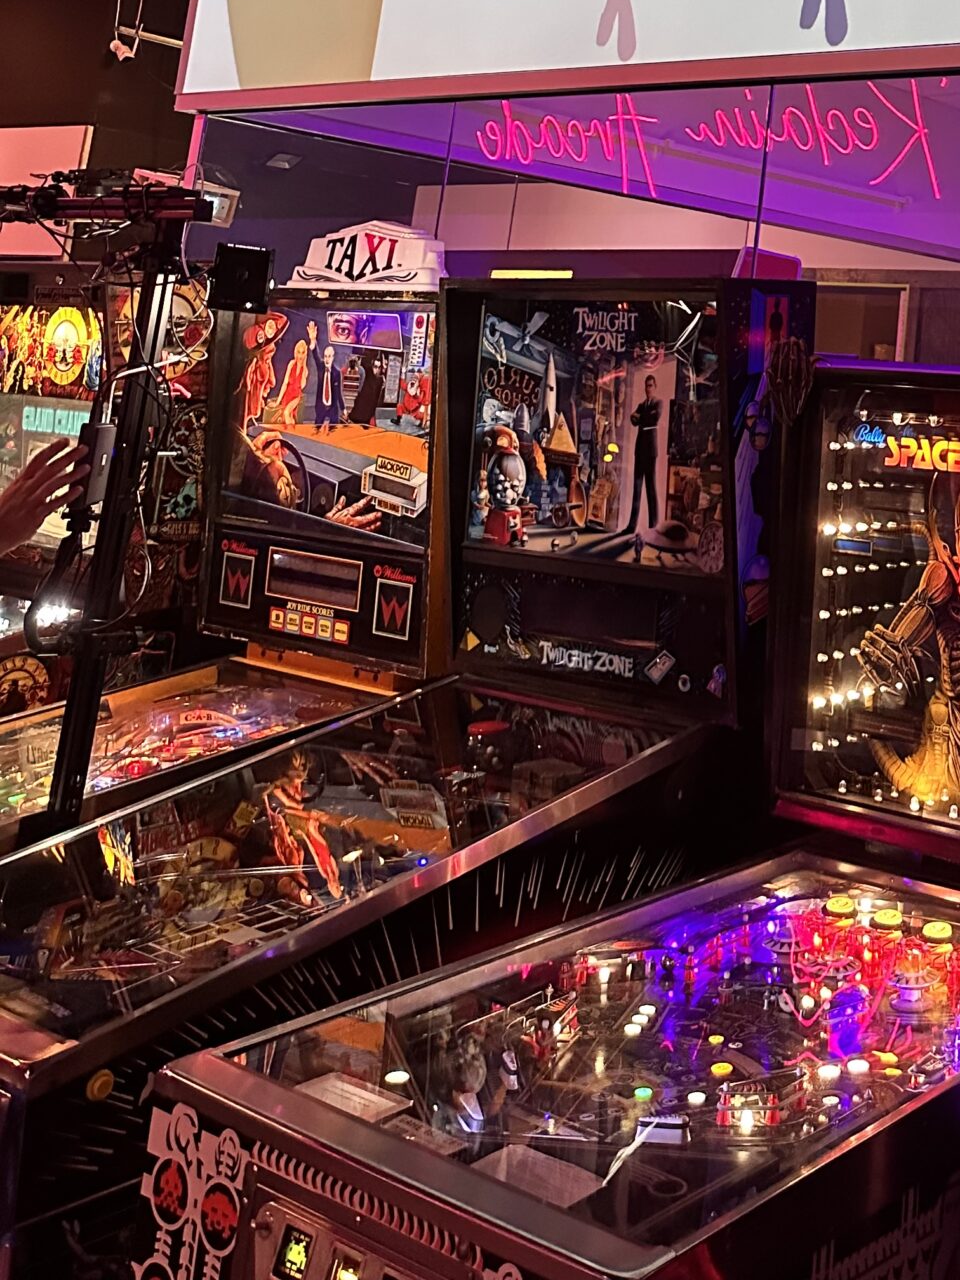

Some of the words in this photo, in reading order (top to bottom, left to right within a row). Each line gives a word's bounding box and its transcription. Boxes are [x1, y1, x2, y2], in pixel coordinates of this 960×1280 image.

[324, 232, 399, 282] TAXI
[573, 307, 639, 334] TWILIGHT
[583, 331, 627, 352] ZONE
[853, 423, 886, 445] Bally
[378, 459, 409, 477] JACKPOT
[381, 565, 417, 584] Williams
[286, 601, 297, 611] JOY
[311, 606, 335, 617] SCORES
[592, 650, 634, 678] ZONE
